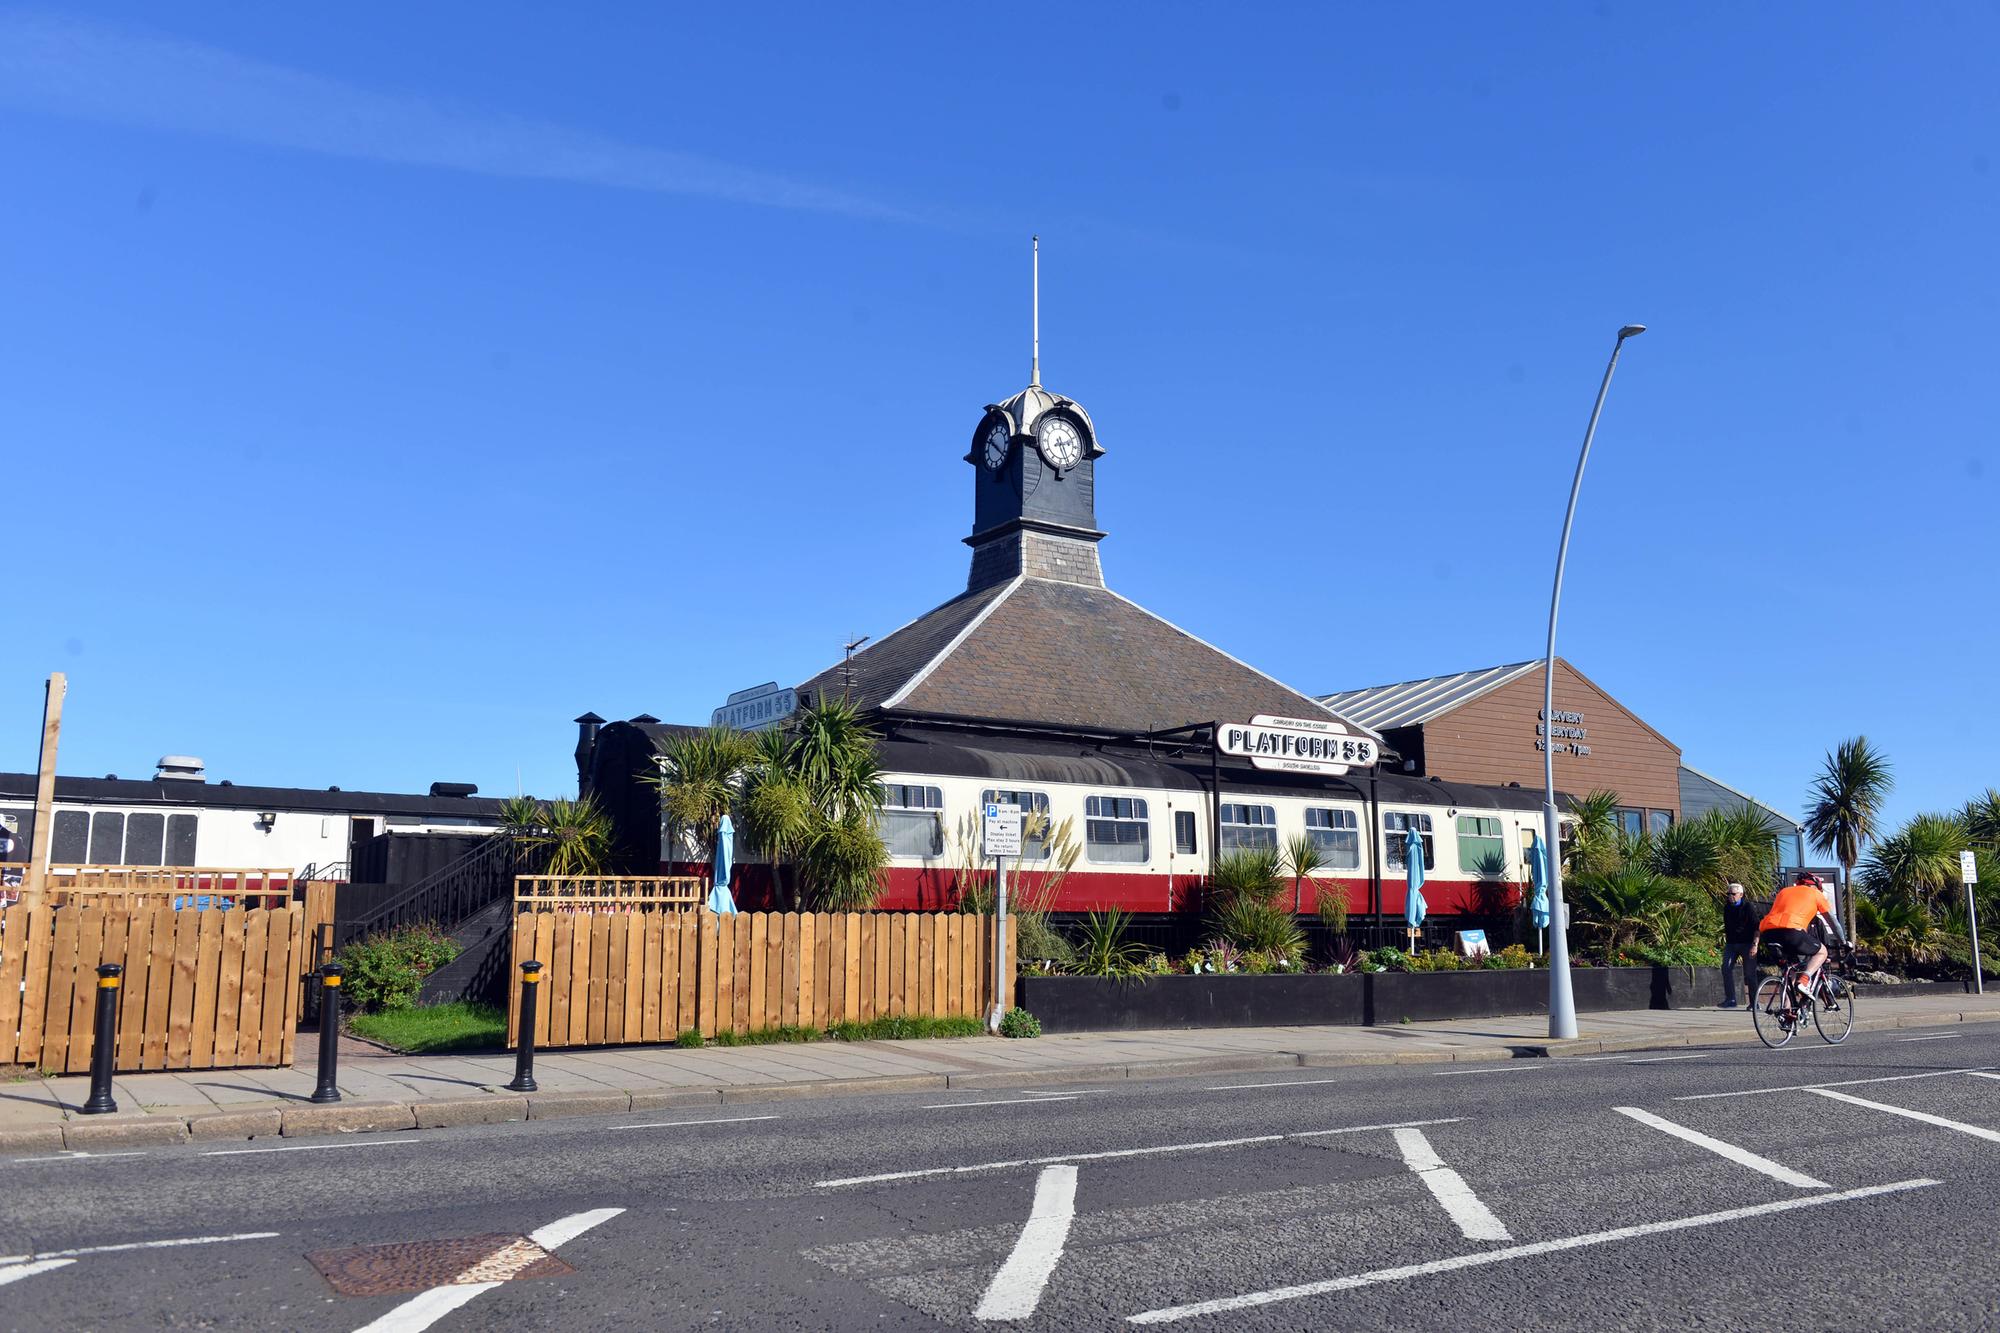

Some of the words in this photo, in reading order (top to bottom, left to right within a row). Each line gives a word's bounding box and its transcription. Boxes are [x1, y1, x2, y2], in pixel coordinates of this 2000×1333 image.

[716, 698, 772, 727] PLATFORM
[1538, 709, 1585, 724] CRVERY
[1536, 724, 1588, 740] EERYDAY
[1228, 729, 1338, 759] PLATFORM
[989, 806, 997, 817] P
